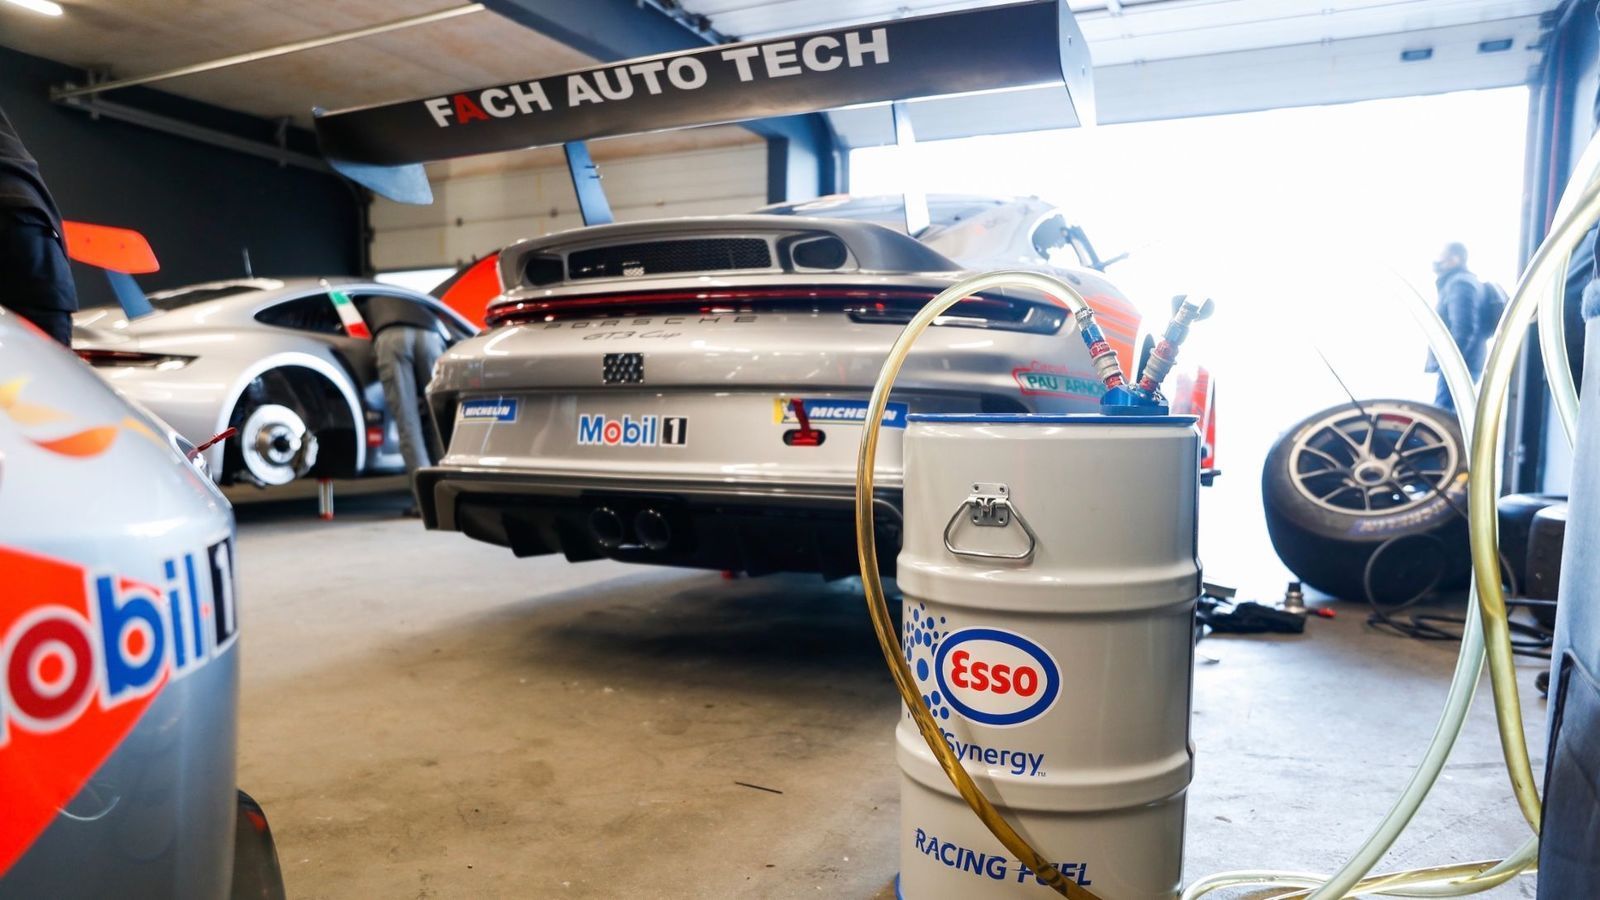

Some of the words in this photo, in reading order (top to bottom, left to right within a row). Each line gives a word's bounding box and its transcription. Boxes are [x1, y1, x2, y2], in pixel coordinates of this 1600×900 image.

[424, 81, 552, 128] FACH
[567, 56, 707, 107] AUTO
[721, 27, 890, 82] TECH
[544, 315, 758, 330] PORSCHE
[1026, 375, 1058, 390] PAU
[465, 405, 510, 417] MICHELIN
[809, 406, 898, 421] MICHEN
[578, 416, 657, 445] Mobil
[0, 553, 203, 720] obil
[210, 538, 236, 644] 1
[944, 732, 1044, 776] Synergy
[915, 828, 1007, 880] RACING
